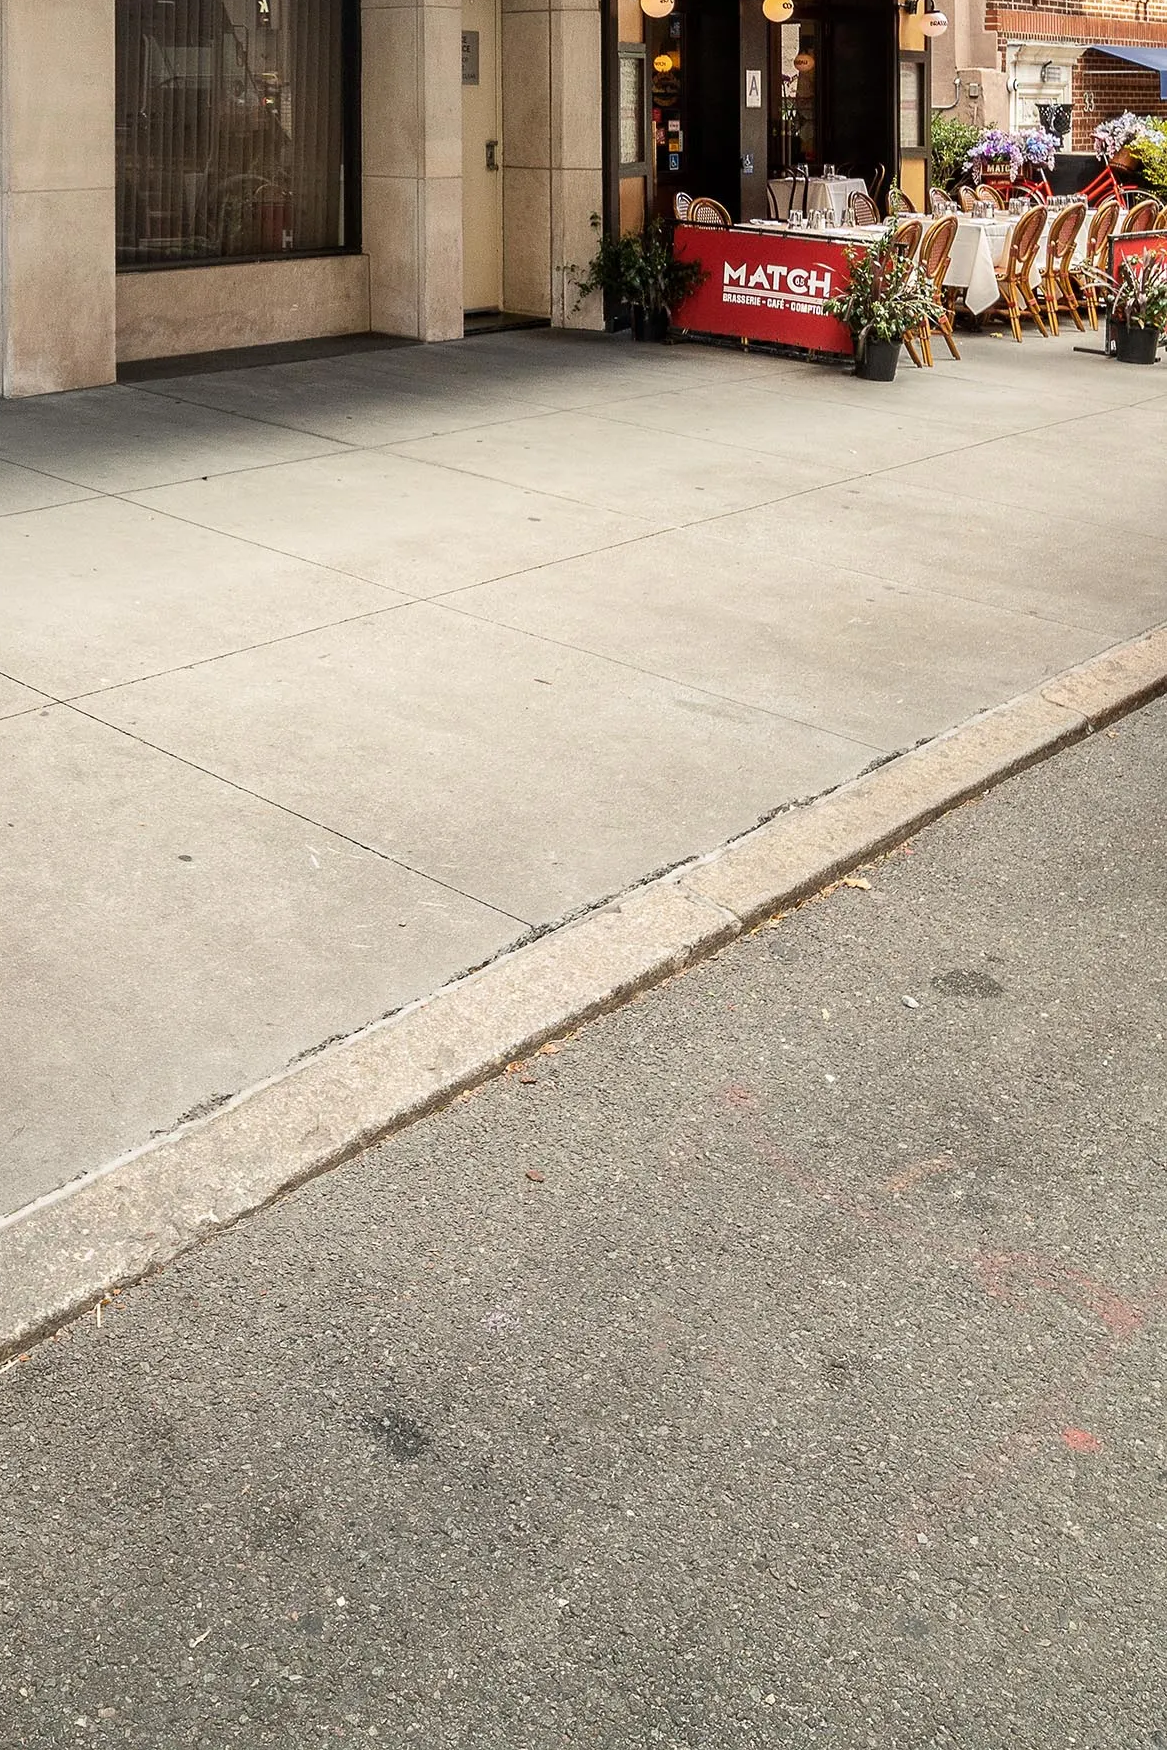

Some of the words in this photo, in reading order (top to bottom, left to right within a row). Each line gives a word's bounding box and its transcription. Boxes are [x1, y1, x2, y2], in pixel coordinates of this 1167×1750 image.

[749, 75, 759, 97] A
[987, 164, 1011, 173] MATC
[723, 261, 832, 298] MATCH
[723, 293, 761, 307] BRASSERIE
[767, 299, 785, 310] CAFÉ
[791, 302, 829, 317] COMPTOI
